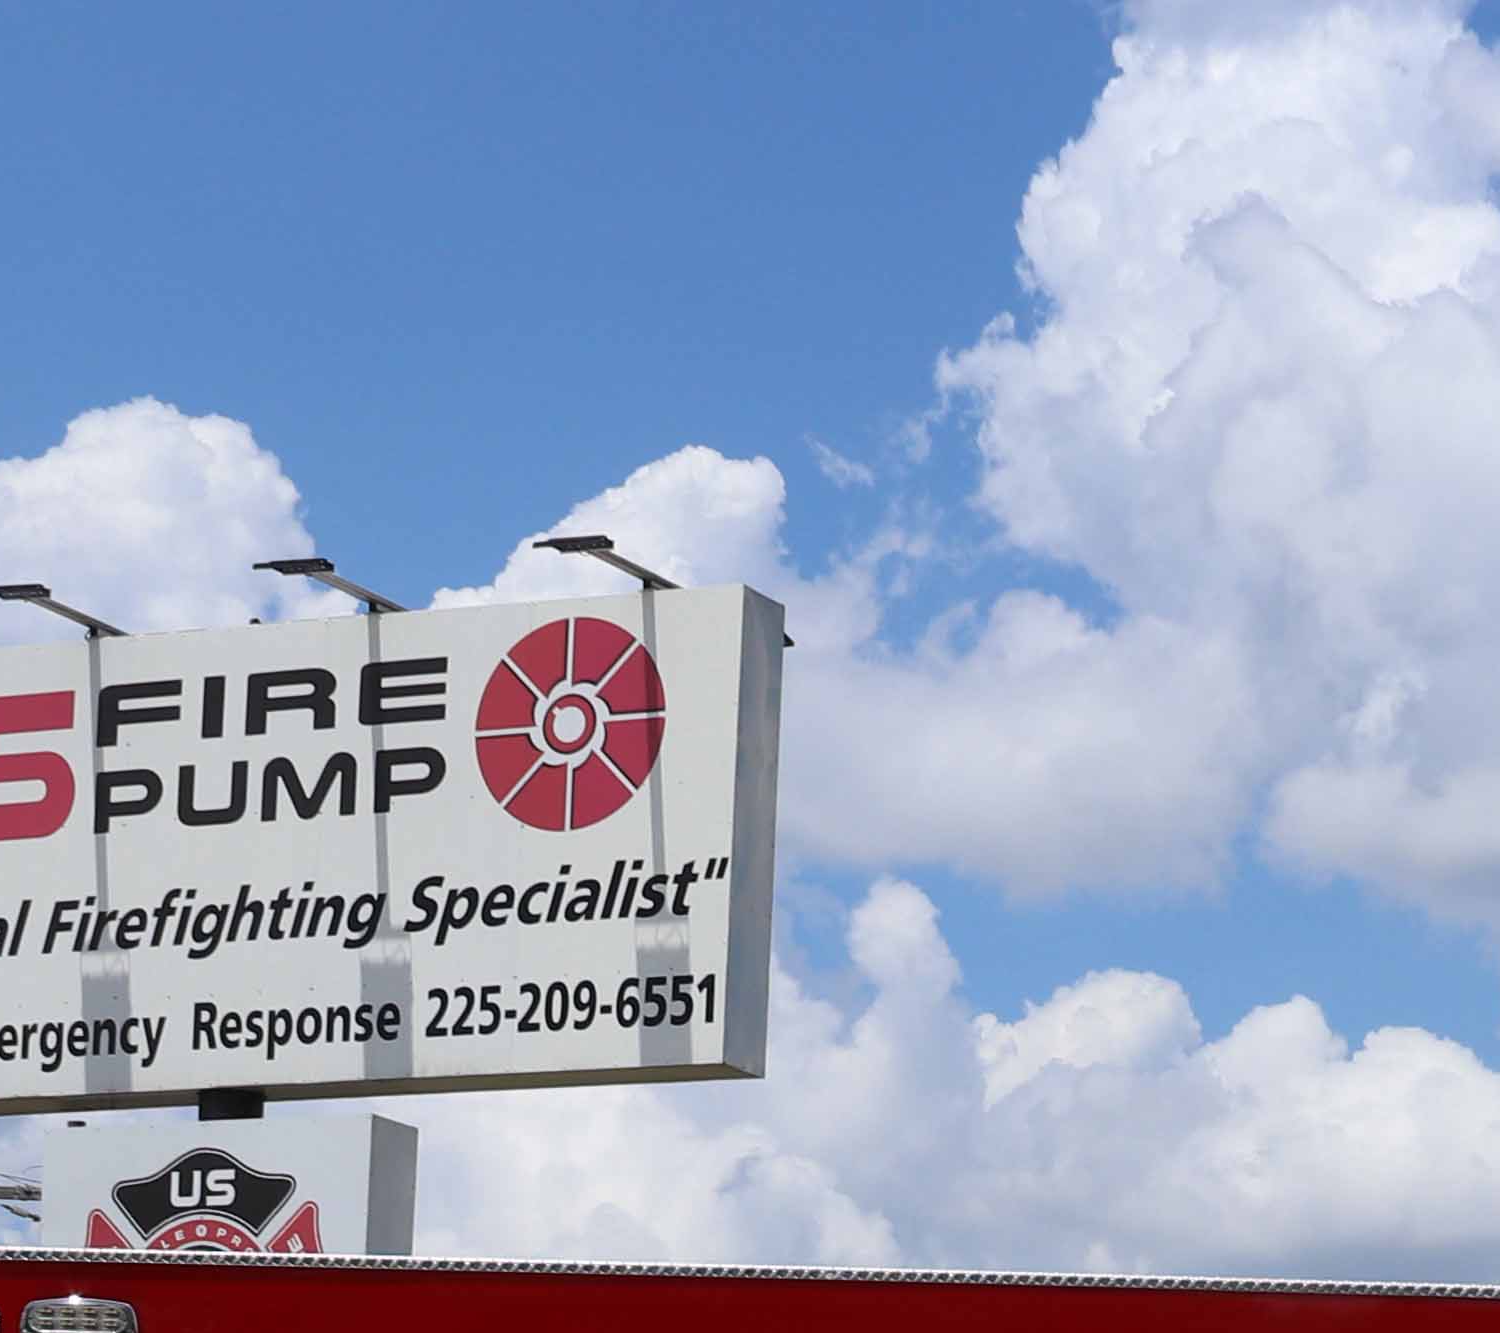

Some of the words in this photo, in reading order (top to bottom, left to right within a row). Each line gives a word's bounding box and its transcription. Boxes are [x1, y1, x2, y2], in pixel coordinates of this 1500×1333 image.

[96, 656, 449, 748] FIRE
[93, 746, 447, 835] PUMP
[41, 881, 388, 960] Firefighting
[403, 856, 730, 946] Specialist"
[192, 1001, 402, 1061] Response
[425, 973, 717, 1037] 225-209-6551
[170, 1168, 236, 1208] US
